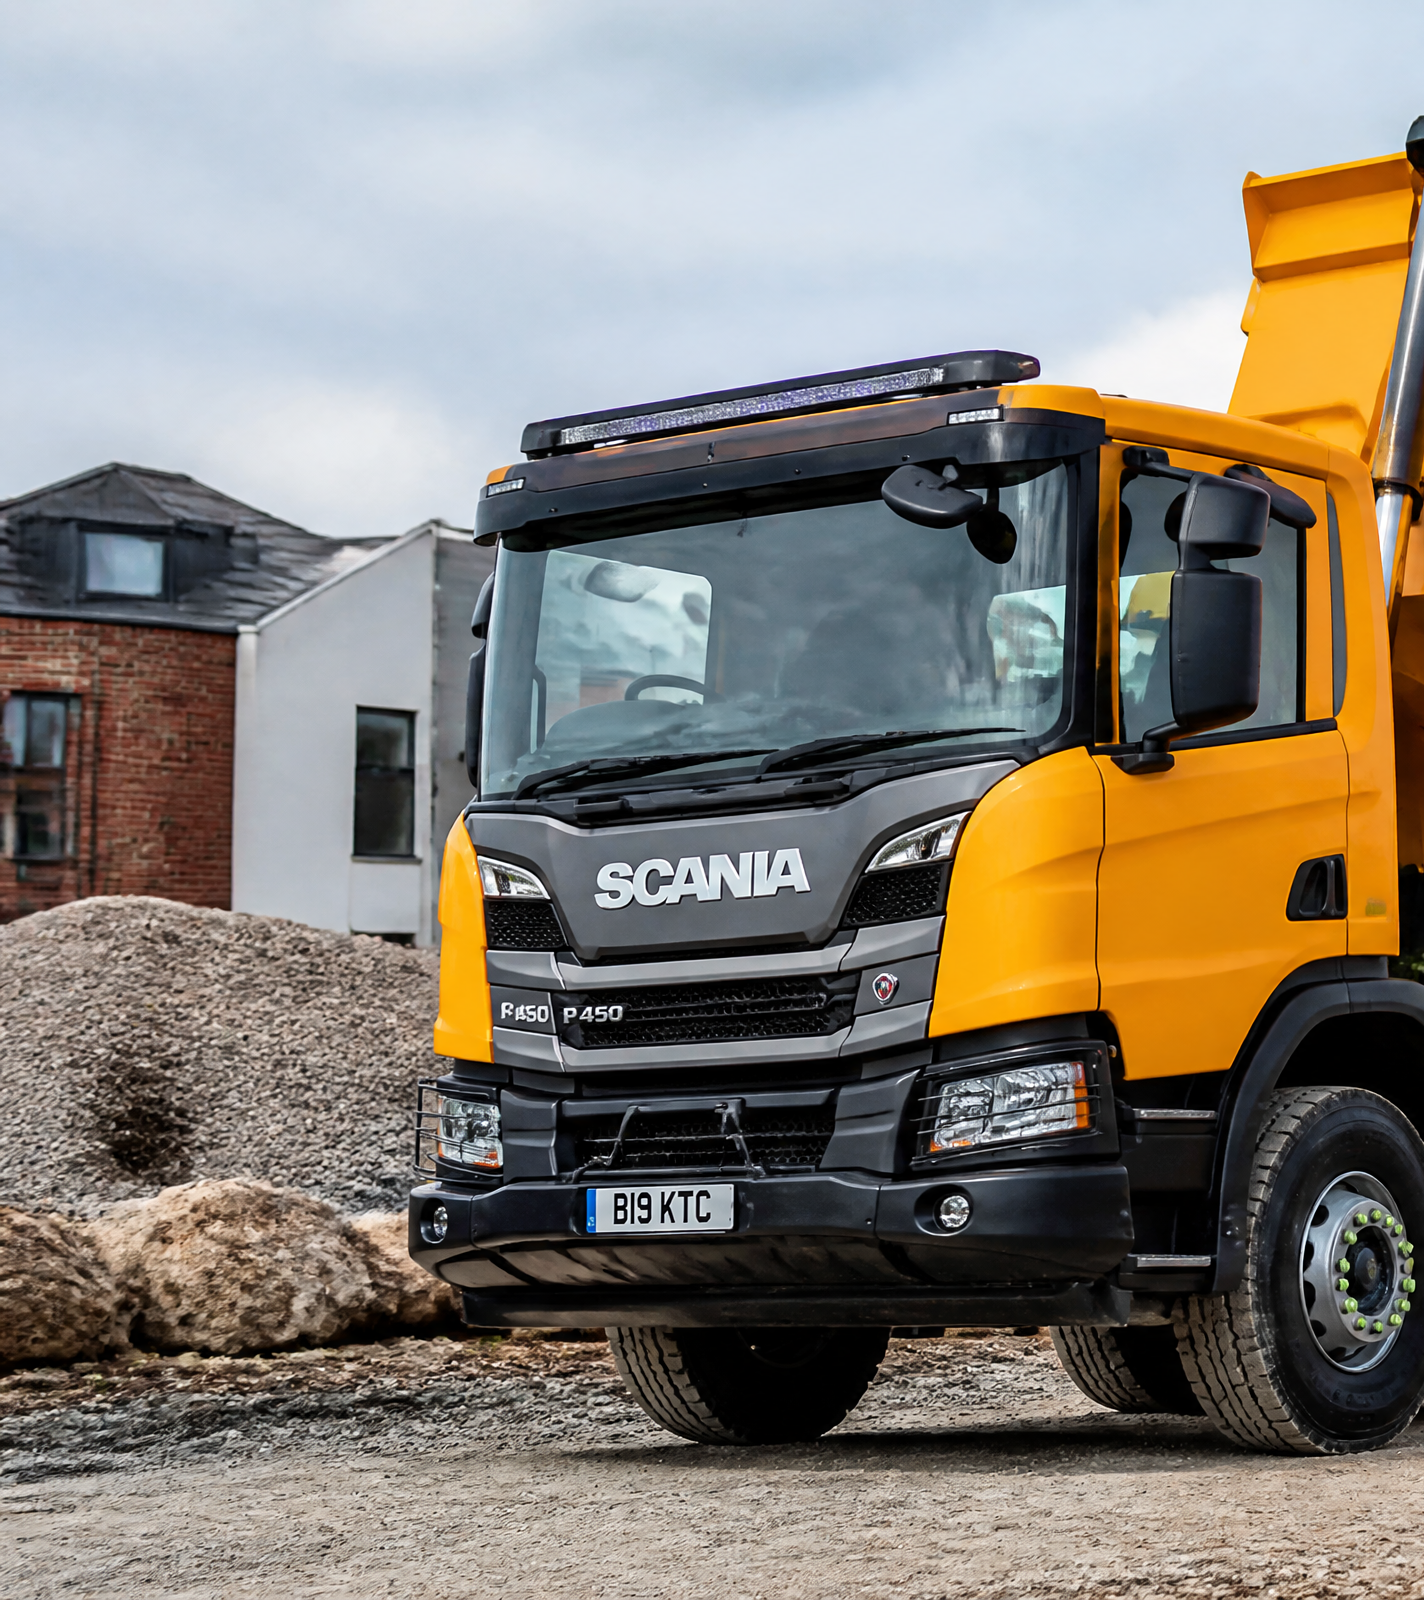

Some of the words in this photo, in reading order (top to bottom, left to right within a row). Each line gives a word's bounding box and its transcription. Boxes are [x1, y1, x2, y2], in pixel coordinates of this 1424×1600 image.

[594, 848, 811, 909] SCANIA
[613, 1192, 652, 1225] B19
[660, 1190, 711, 1224] KTC
